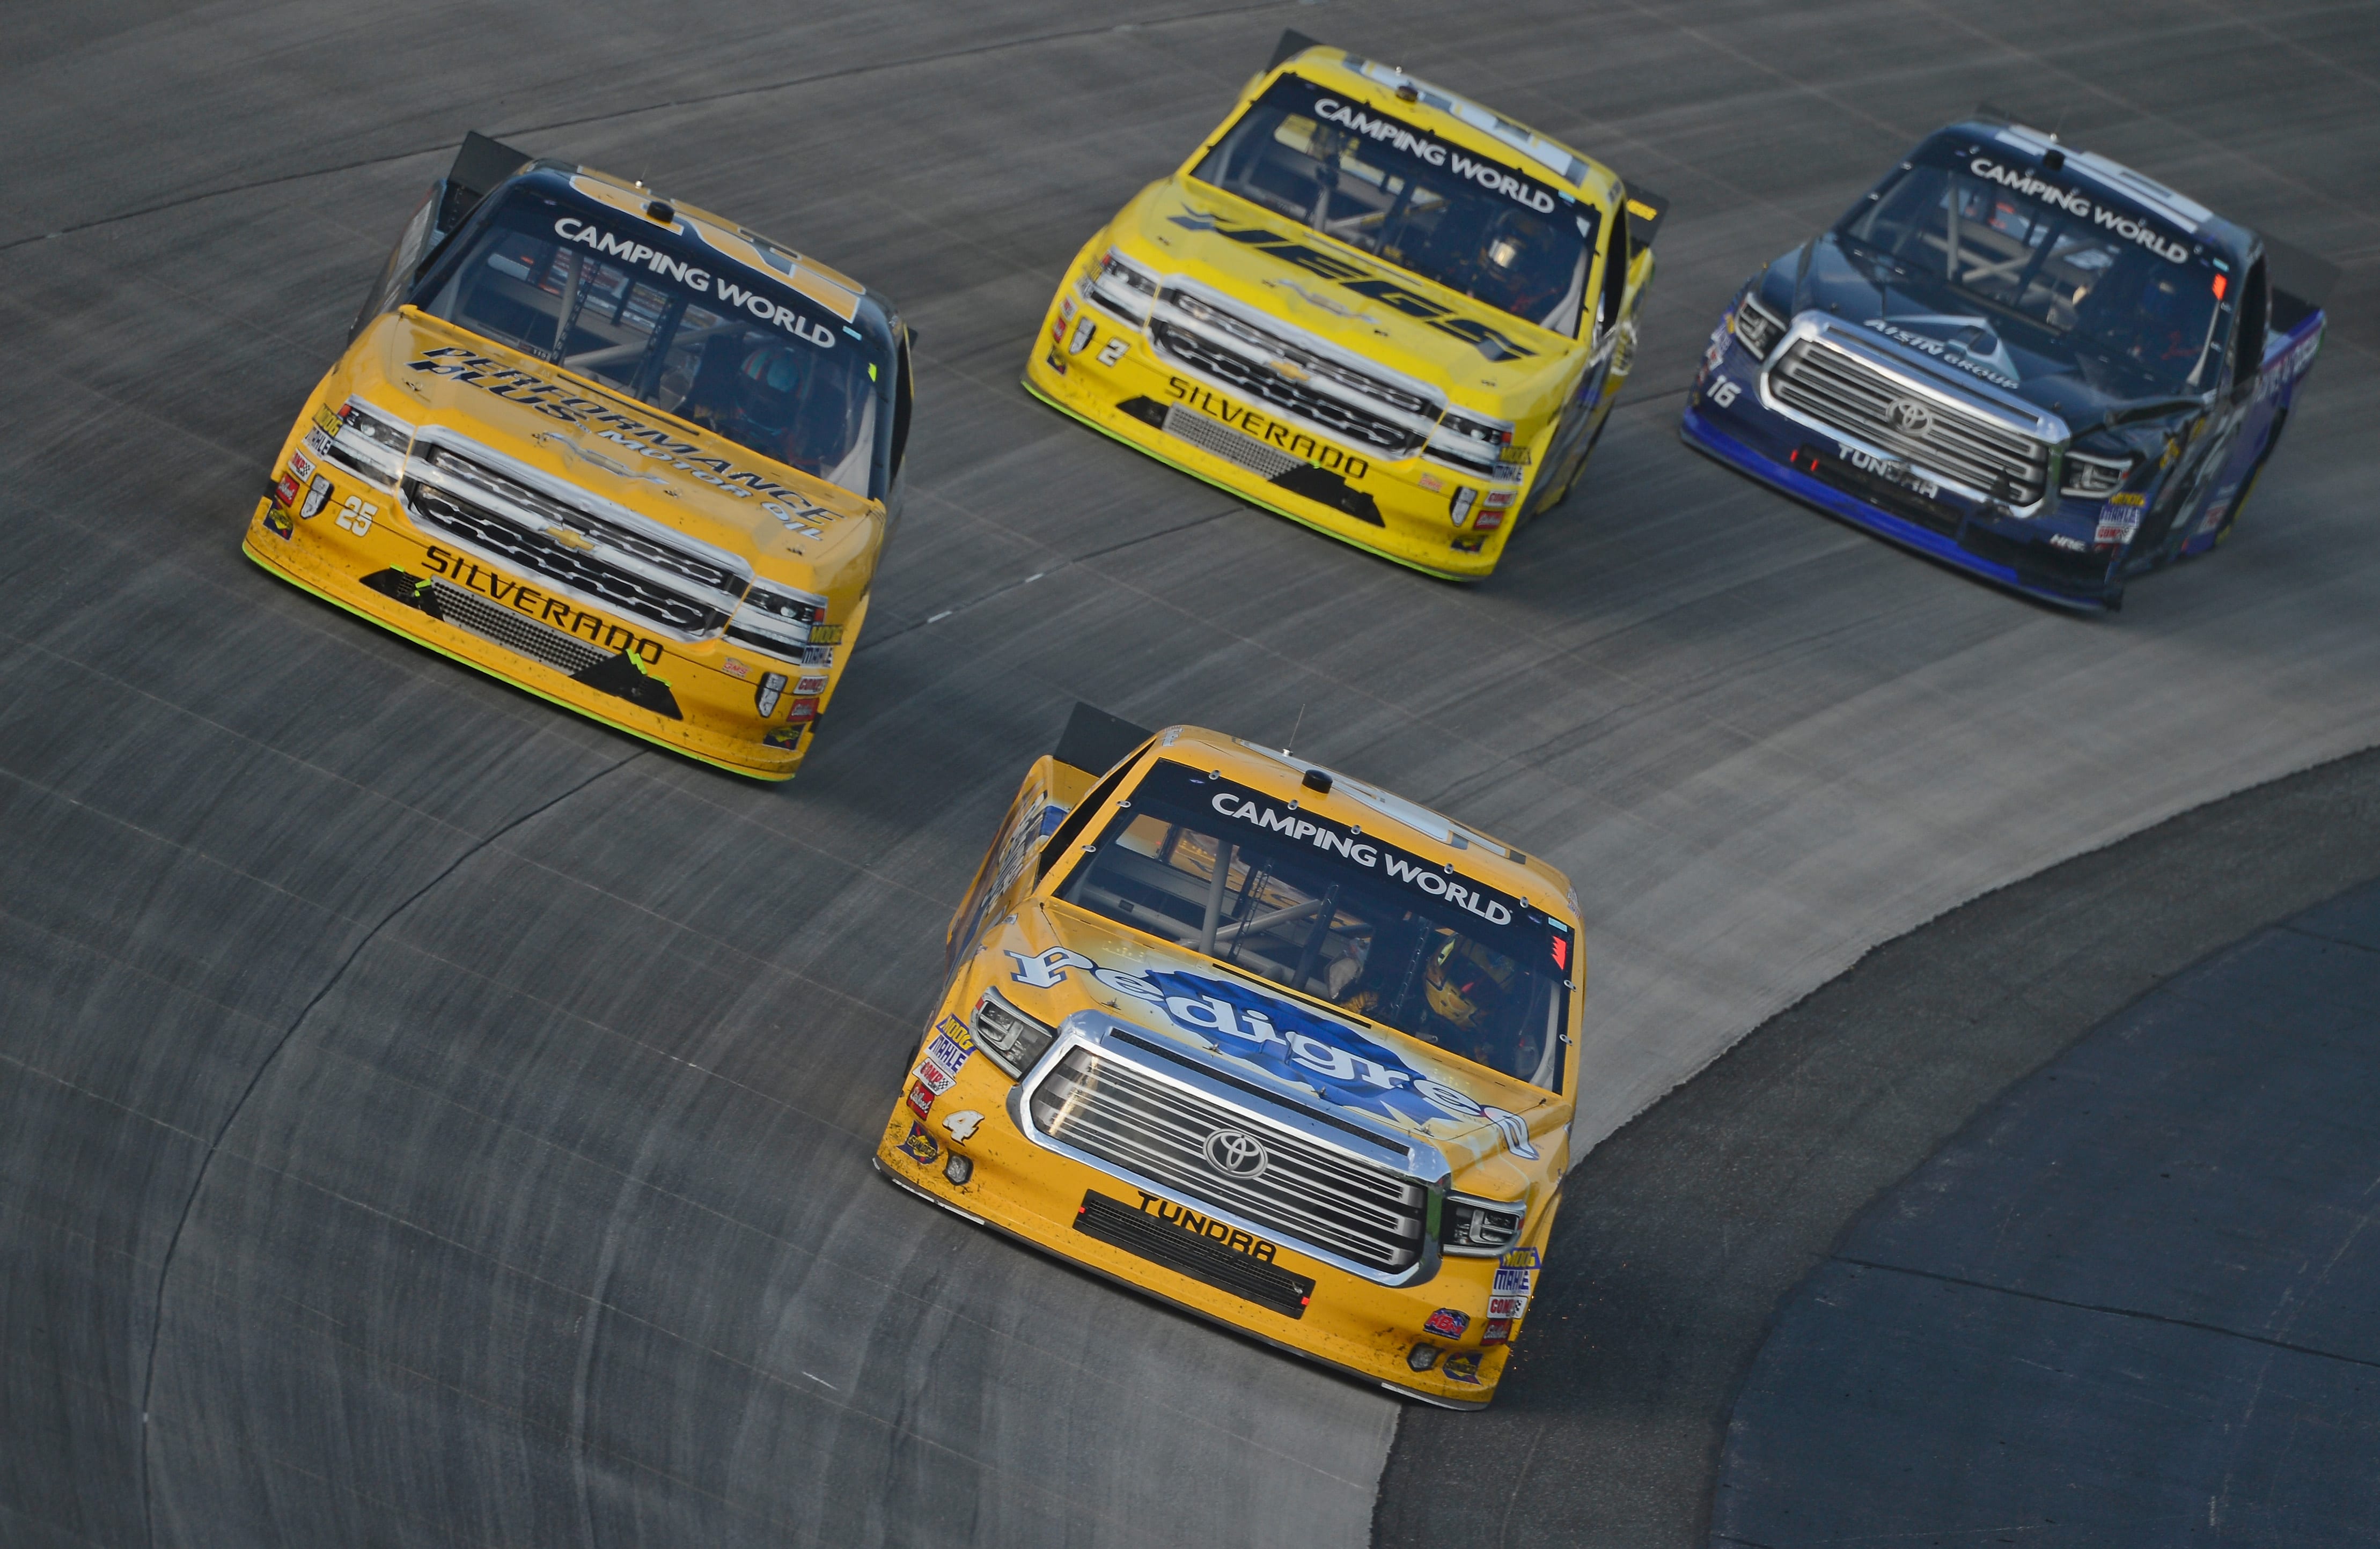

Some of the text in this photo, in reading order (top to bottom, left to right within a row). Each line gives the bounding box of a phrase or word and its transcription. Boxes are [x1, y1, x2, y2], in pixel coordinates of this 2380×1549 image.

[1314, 98, 1555, 213] CAMPING WORLD
[1970, 159, 2188, 264] CAMPING WORLD
[554, 217, 835, 349] CAMPING WORLD
[1097, 337, 1130, 367] 2
[1707, 374, 1742, 408] 16
[406, 359, 824, 541] PLUS MOTOR OIL
[421, 347, 846, 526] PERFORMANCE
[1166, 377, 1368, 478] SILVERADO
[335, 495, 378, 537] 25
[421, 545, 663, 665] SILVERADO
[1211, 792, 1377, 868] CAMPING
[1385, 853, 1512, 927] WORLD
[920, 1062, 943, 1083] COMP
[940, 1017, 974, 1050] MOOG
[1004, 945, 1540, 1161] Pedigree
[942, 1110, 985, 1146] 4
[1137, 1191, 1277, 1263] TUNDRA
